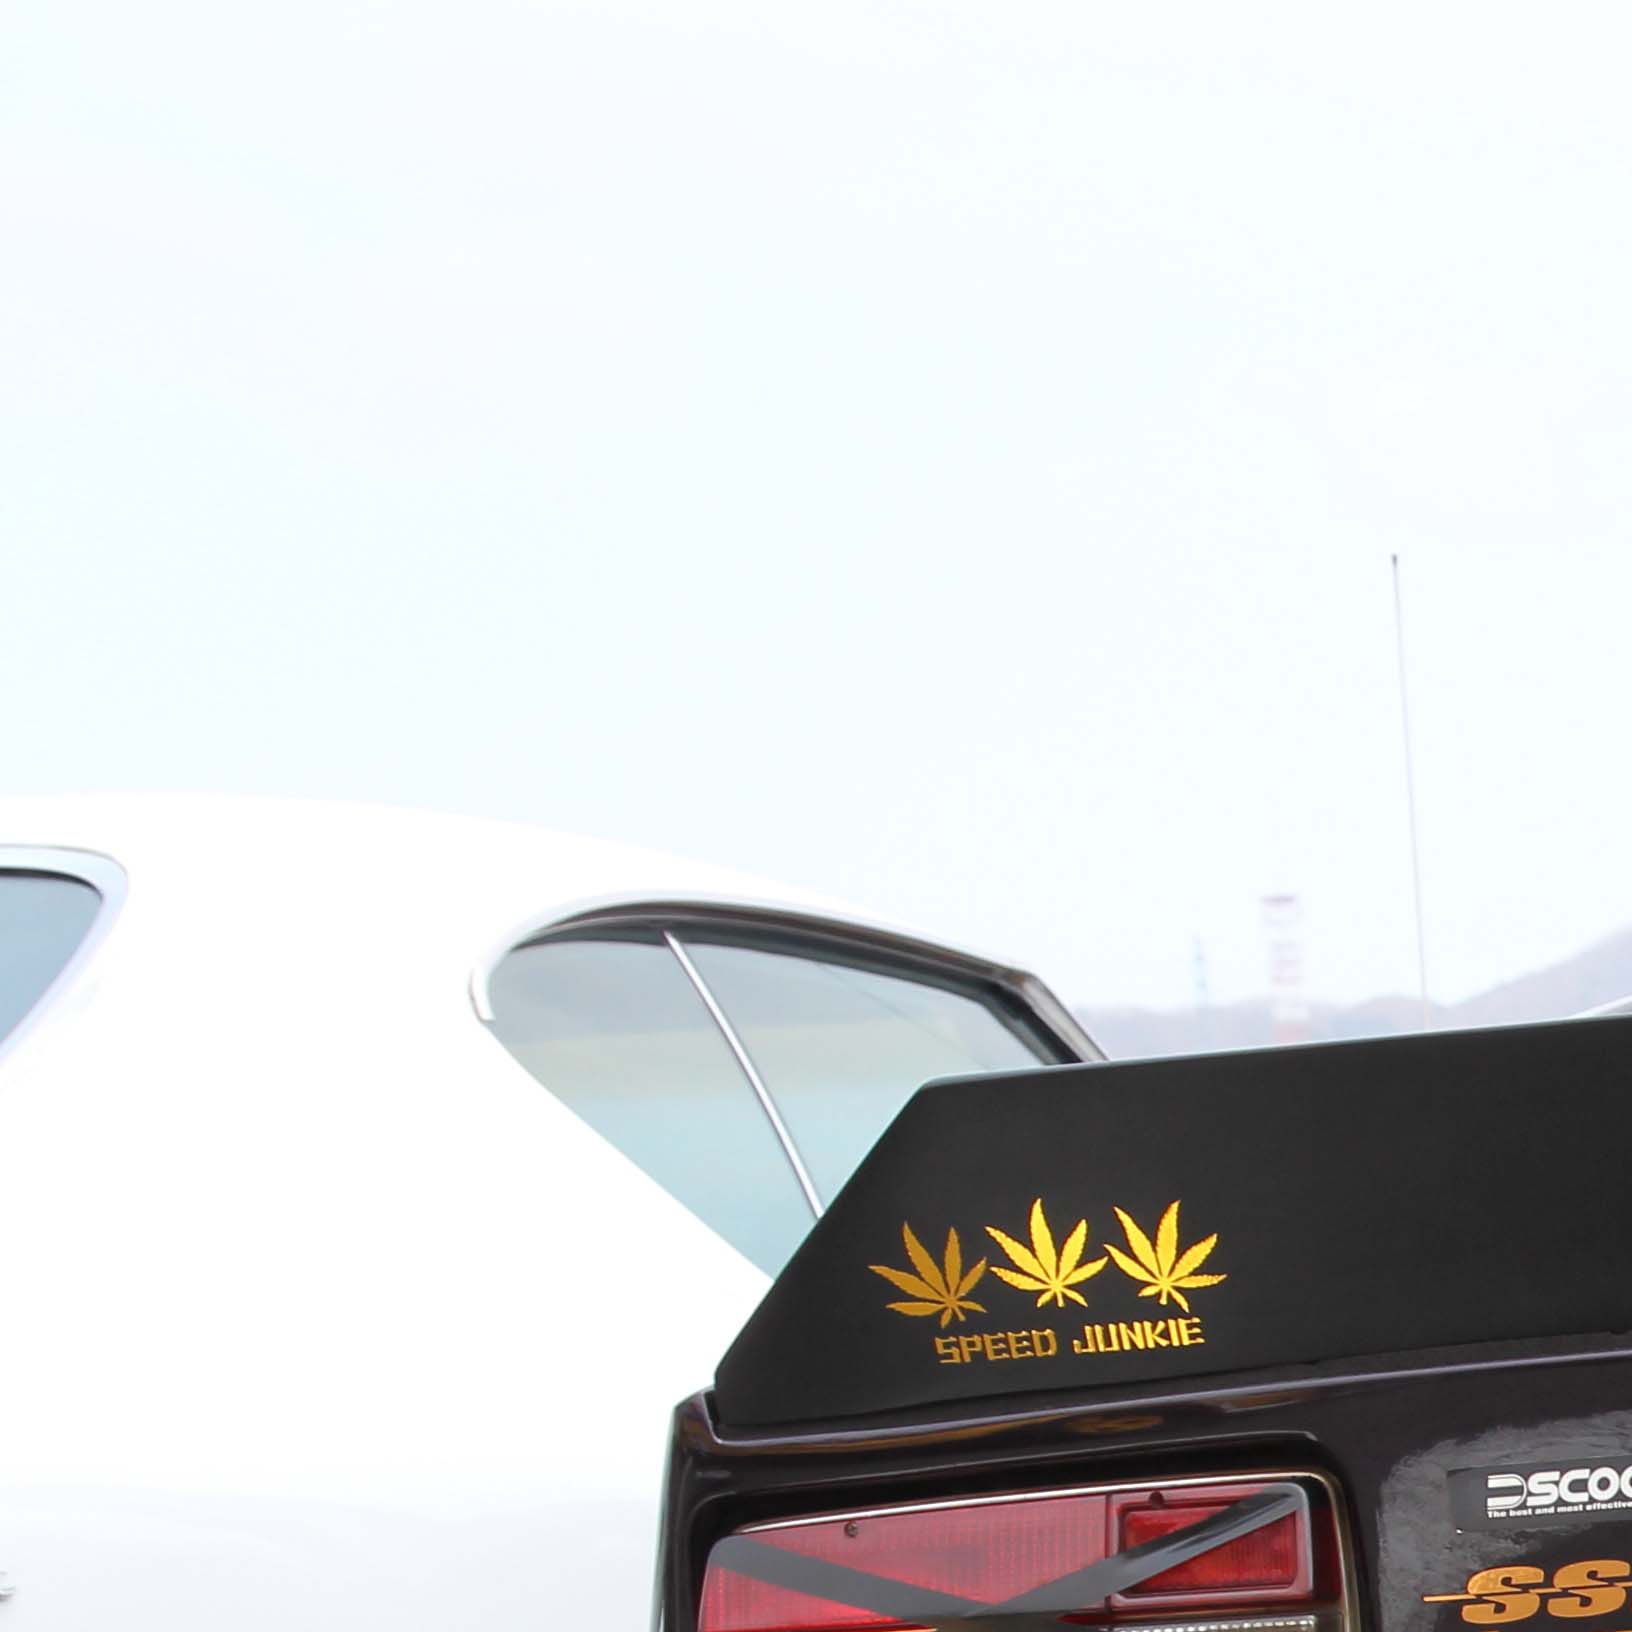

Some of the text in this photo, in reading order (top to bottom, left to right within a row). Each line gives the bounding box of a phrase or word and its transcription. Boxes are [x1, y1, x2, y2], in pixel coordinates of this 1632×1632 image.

[934, 1316, 1206, 1365] SPEED JUNKIE
[1487, 1510, 1508, 1519] The
[1509, 1508, 1533, 1518] best
[1534, 1506, 1556, 1516] and
[1556, 1504, 1585, 1514] most
